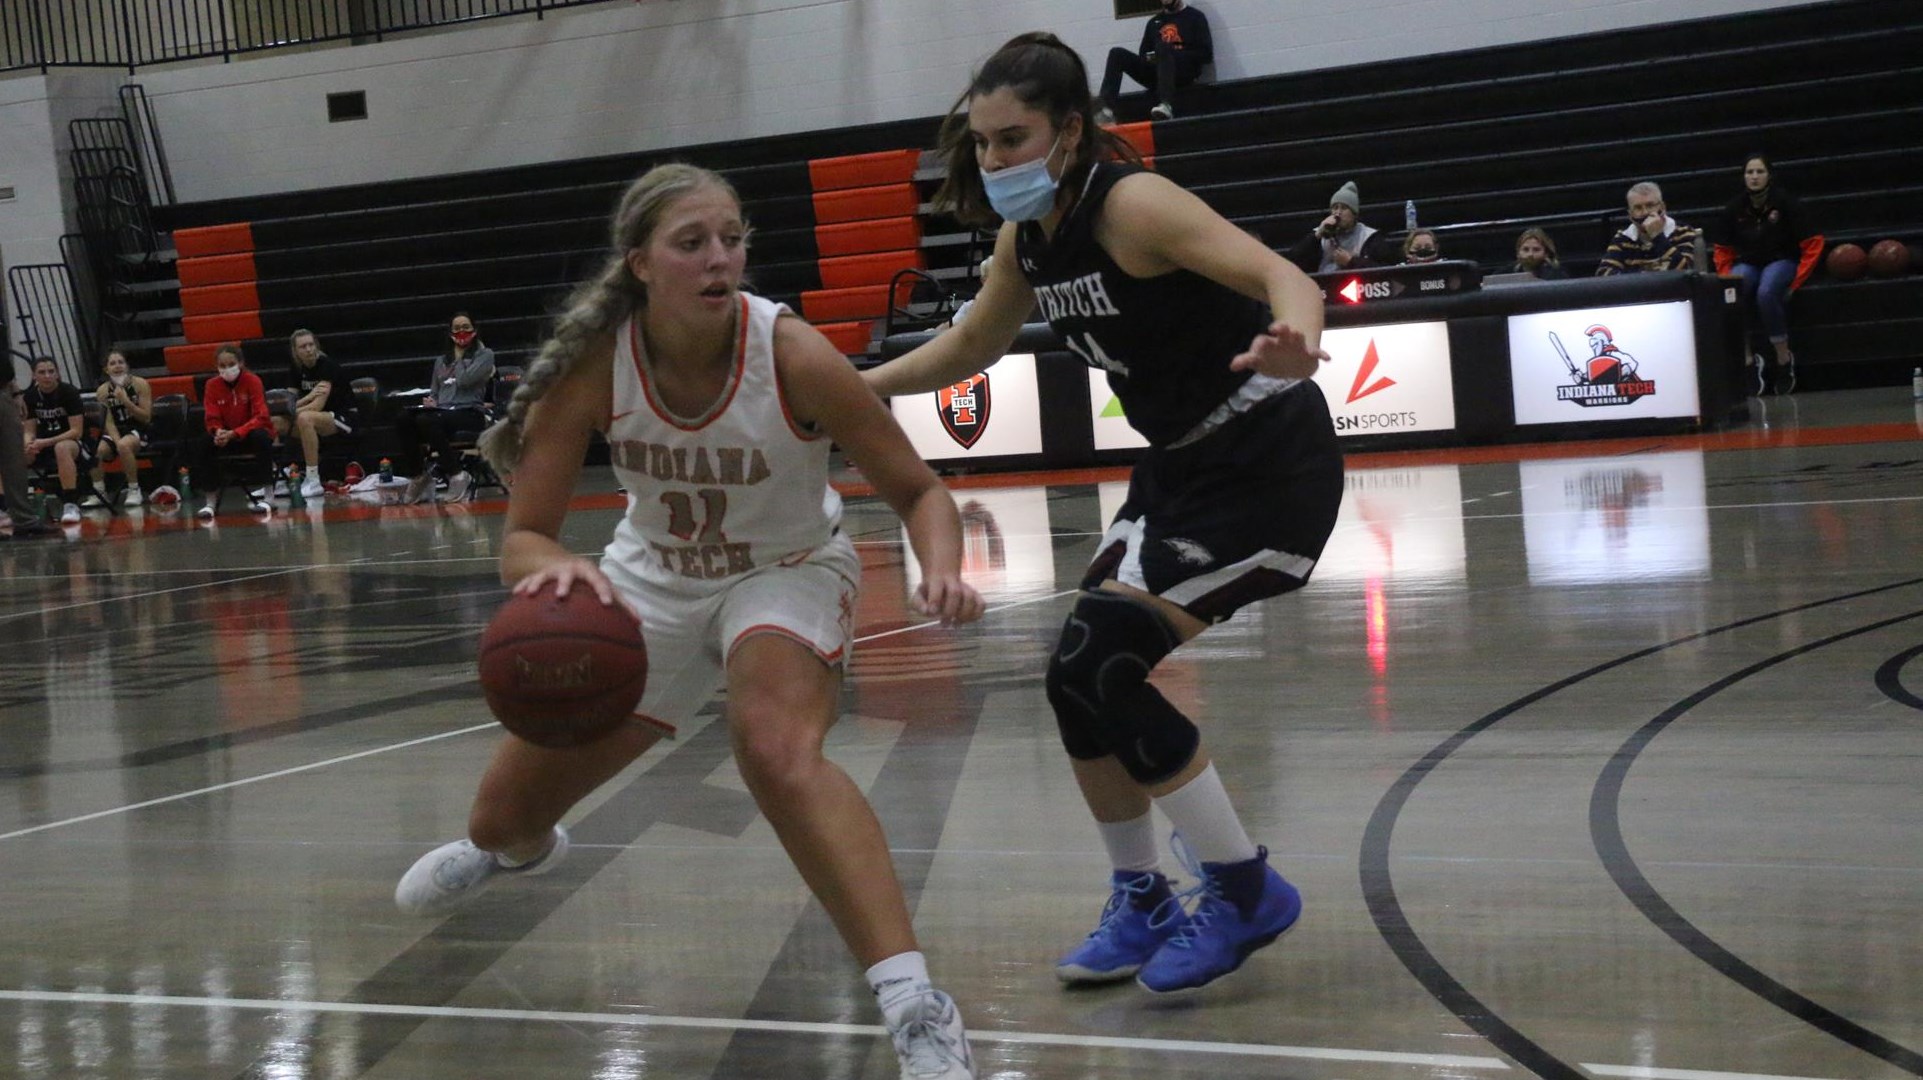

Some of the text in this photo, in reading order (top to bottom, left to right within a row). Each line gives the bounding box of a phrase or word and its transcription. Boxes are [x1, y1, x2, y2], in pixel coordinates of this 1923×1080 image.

[1357, 281, 1390, 299] POSS
[1420, 279, 1445, 291] BONUS
[1558, 381, 1654, 399] INDIANA TECH
[954, 398, 973, 406] TECH
[610, 440, 771, 485] INDIANA
[650, 541, 755, 579] TECH
